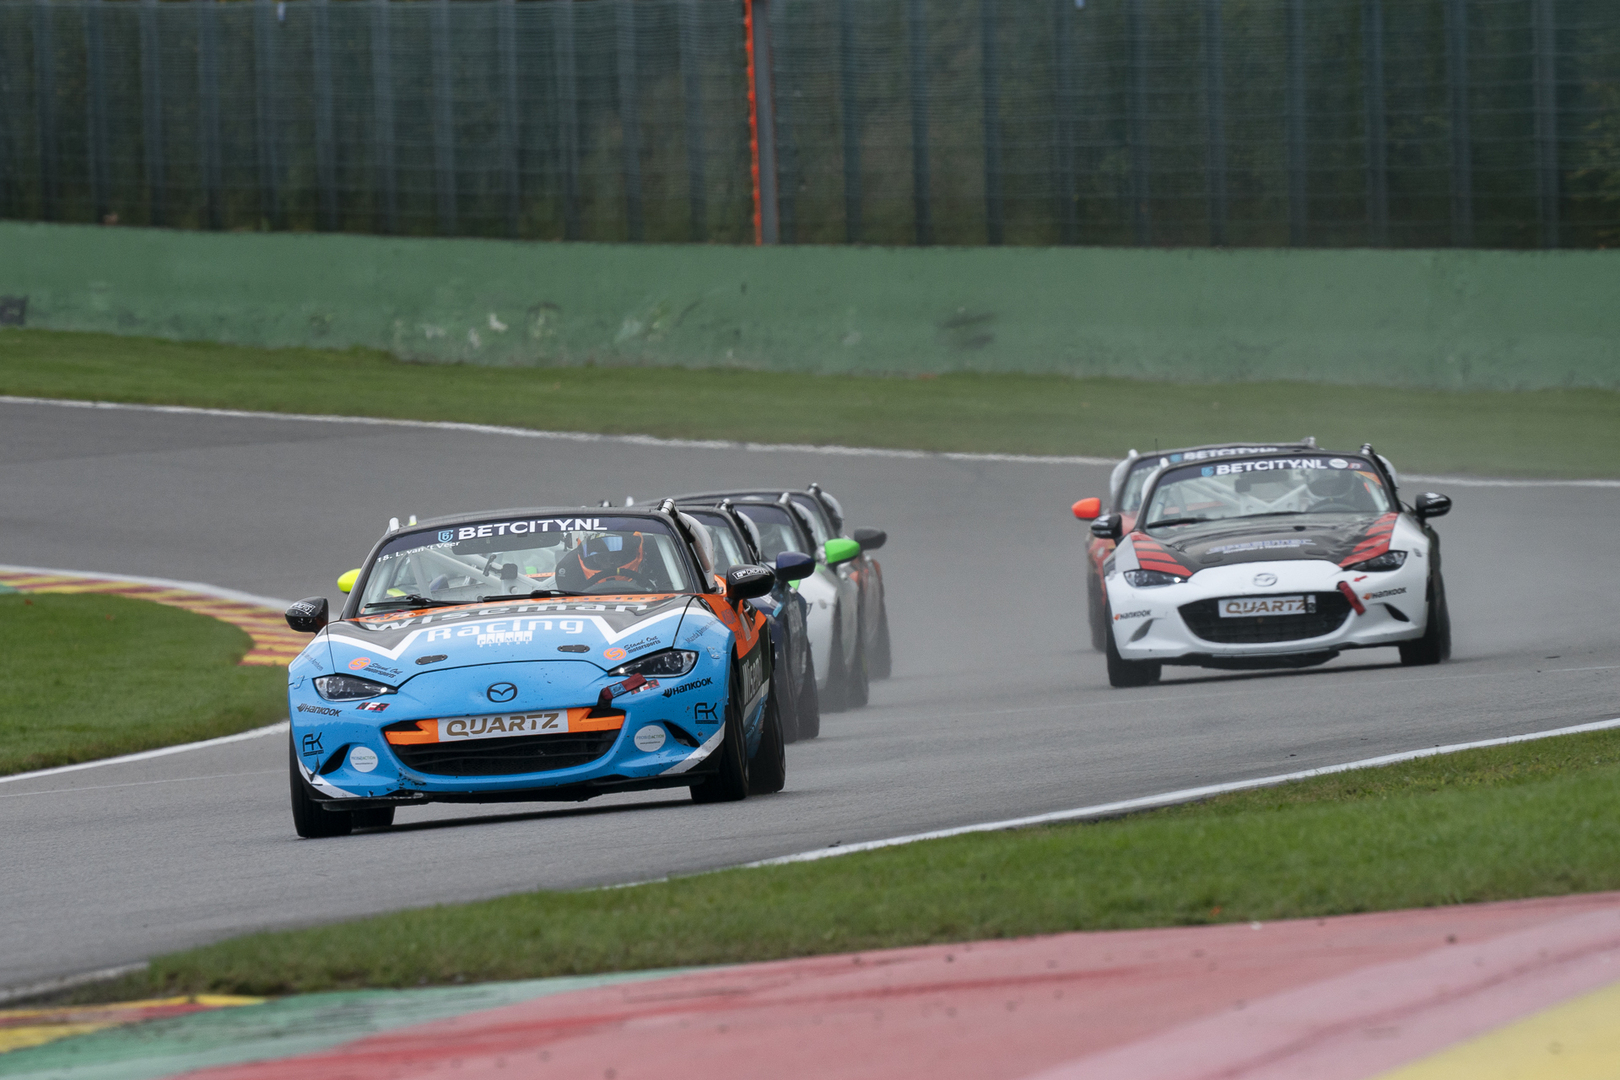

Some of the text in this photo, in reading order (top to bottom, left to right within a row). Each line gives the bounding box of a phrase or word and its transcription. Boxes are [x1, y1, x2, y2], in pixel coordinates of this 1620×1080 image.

[1216, 458, 1328, 476] BETCITY.NL
[458, 518, 608, 541] BETCITY.NL
[406, 547, 424, 555] van
[435, 541, 460, 549] Veer
[1225, 599, 1306, 615] QUARTZ
[427, 619, 584, 642] Racing
[446, 712, 560, 737] QUARTZ
